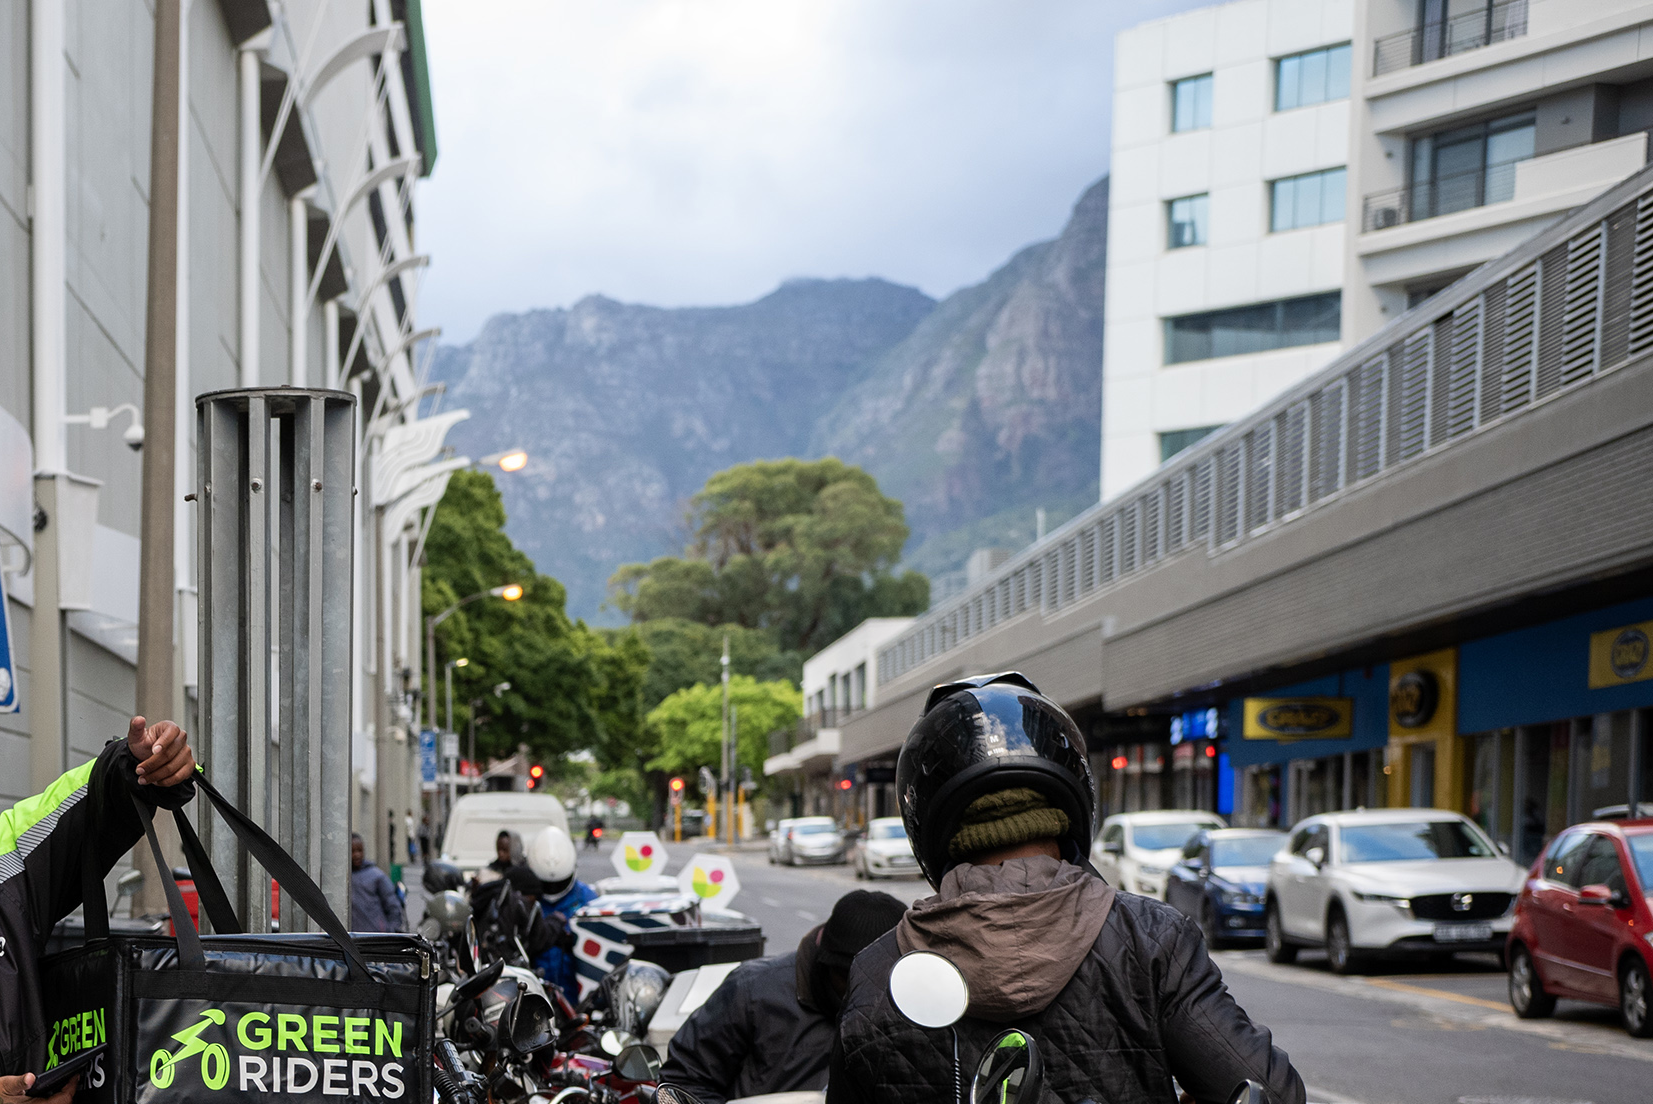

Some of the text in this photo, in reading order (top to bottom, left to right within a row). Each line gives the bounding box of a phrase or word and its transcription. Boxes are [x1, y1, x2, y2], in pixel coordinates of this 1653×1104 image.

[60, 1008, 106, 1056] GREEN
[236, 1011, 403, 1057] GREEN
[238, 1055, 405, 1099] RIDERS
